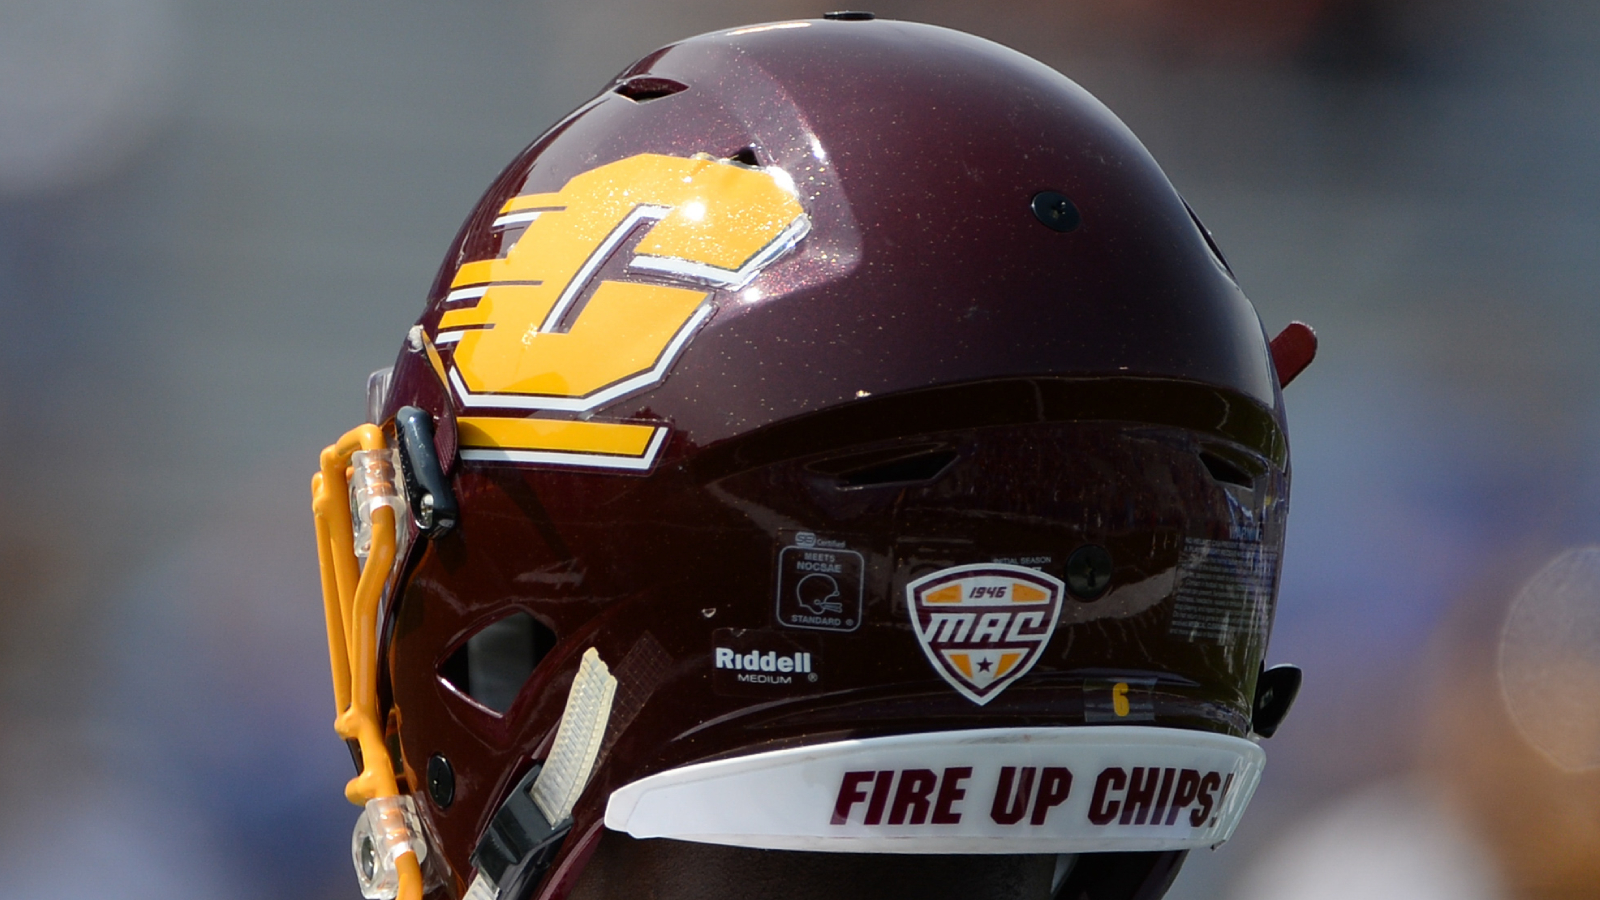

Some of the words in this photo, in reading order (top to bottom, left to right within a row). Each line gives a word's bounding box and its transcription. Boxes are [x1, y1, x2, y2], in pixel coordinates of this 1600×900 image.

[804, 552, 836, 563] MEETS
[1020, 556, 1052, 565] SEASON
[796, 561, 842, 573] NOCSAE
[969, 587, 1007, 599] 1946
[791, 615, 842, 627] STANDARD
[924, 611, 1048, 643] MAC
[715, 646, 812, 673] Riddell
[737, 673, 792, 684] MEDIUM
[1112, 682, 1130, 717] 6
[830, 767, 974, 826] FIRE
[990, 766, 1074, 826] UP
[1087, 766, 1236, 828] CHIPS!
